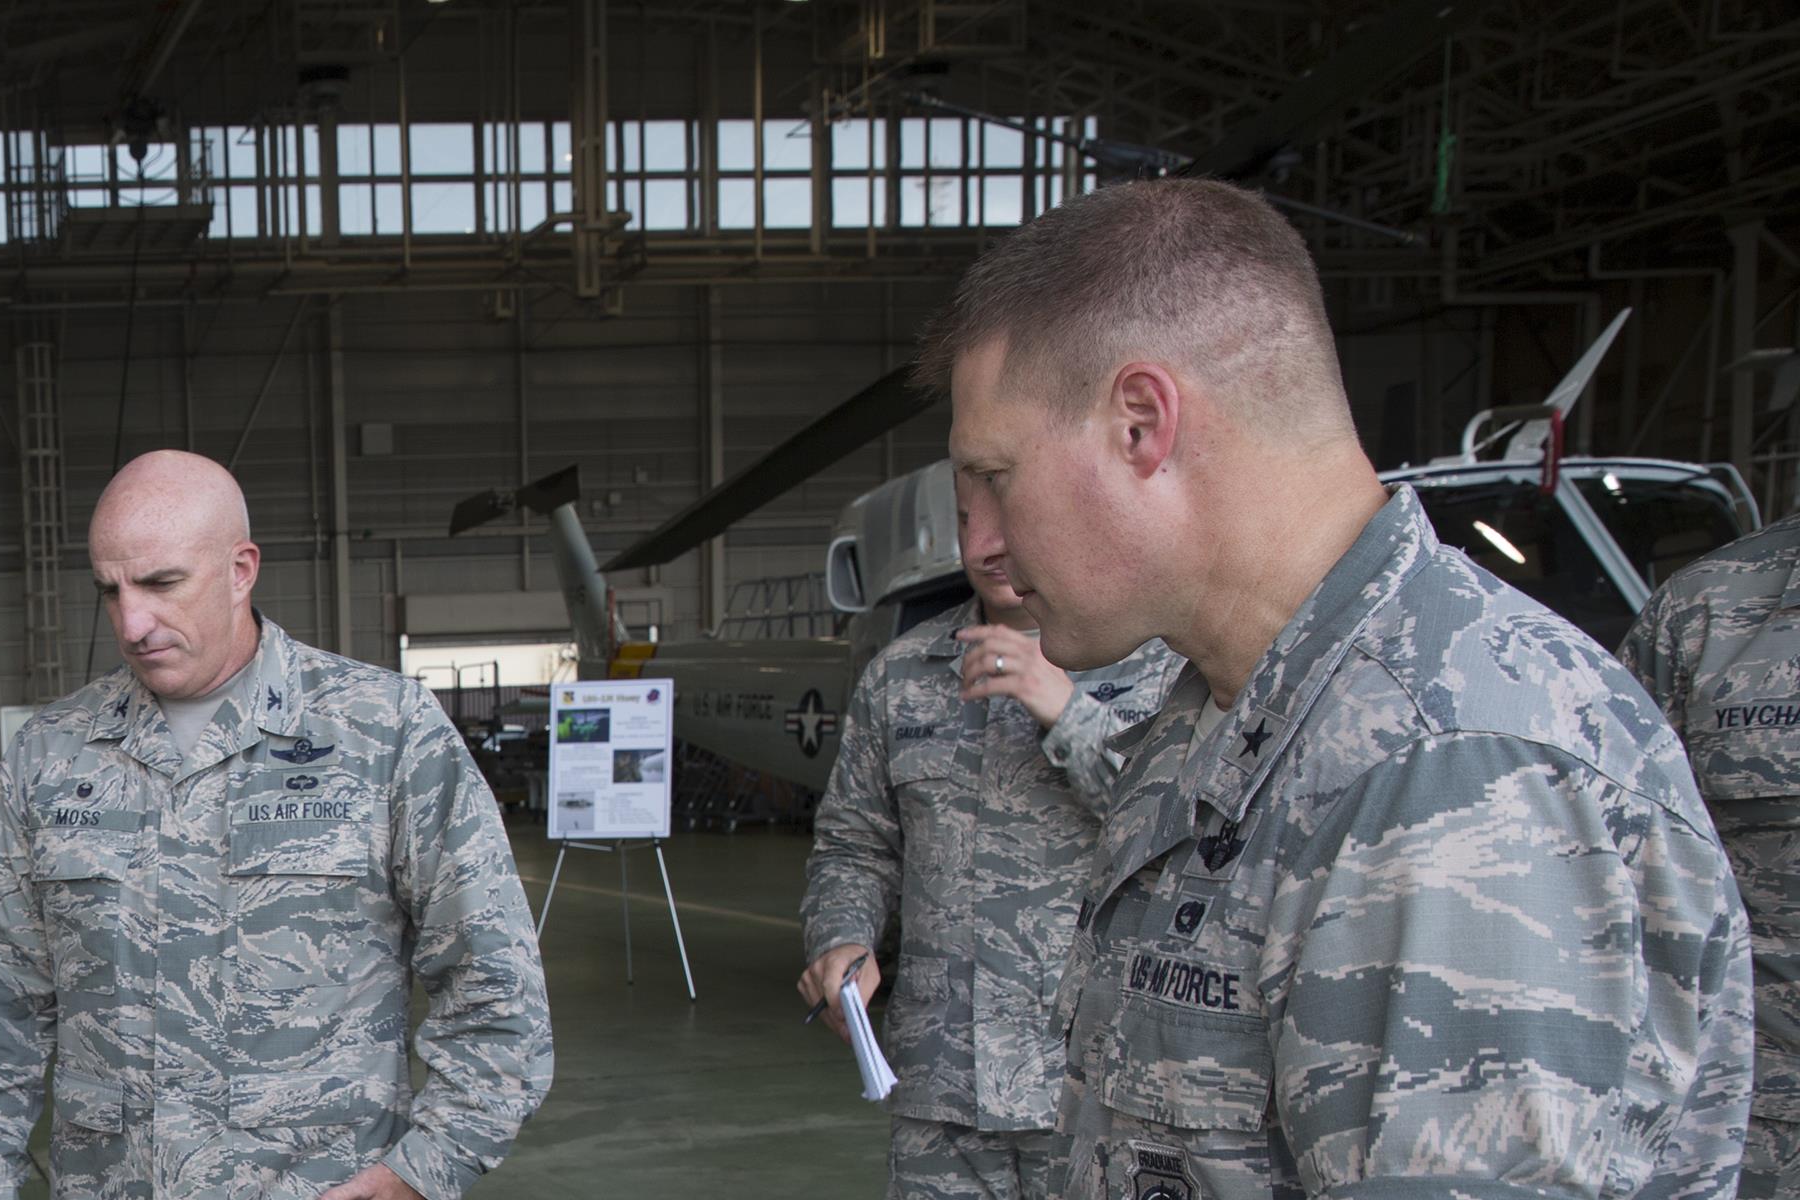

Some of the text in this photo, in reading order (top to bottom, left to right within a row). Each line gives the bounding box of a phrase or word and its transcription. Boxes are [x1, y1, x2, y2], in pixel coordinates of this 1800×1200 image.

[55, 808, 101, 826] MOSS
[273, 803, 298, 820] AIR
[303, 801, 352, 819] FORCE
[1163, 961, 1240, 1010] FORCE
[1138, 1150, 1183, 1172] GRADUATE
